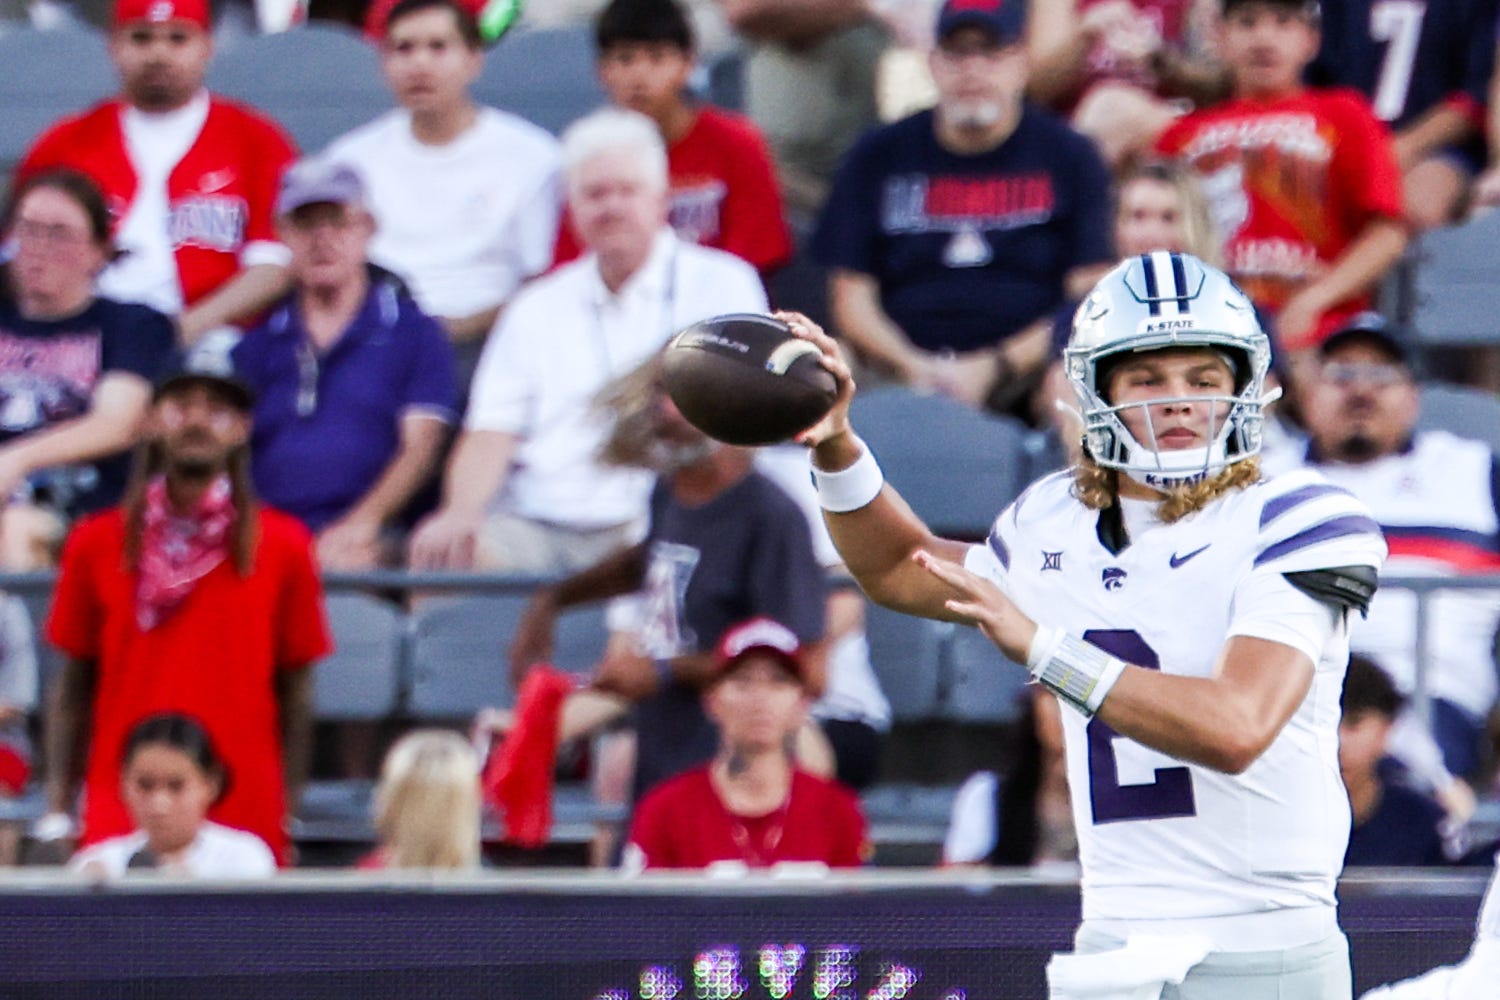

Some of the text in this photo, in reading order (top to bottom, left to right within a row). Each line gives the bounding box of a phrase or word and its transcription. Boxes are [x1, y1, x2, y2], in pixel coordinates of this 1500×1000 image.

[1369, 0, 1427, 121] 7
[1146, 319, 1194, 332] K-STATE
[1040, 549, 1064, 571] XII
[1081, 627, 1197, 826] 2
